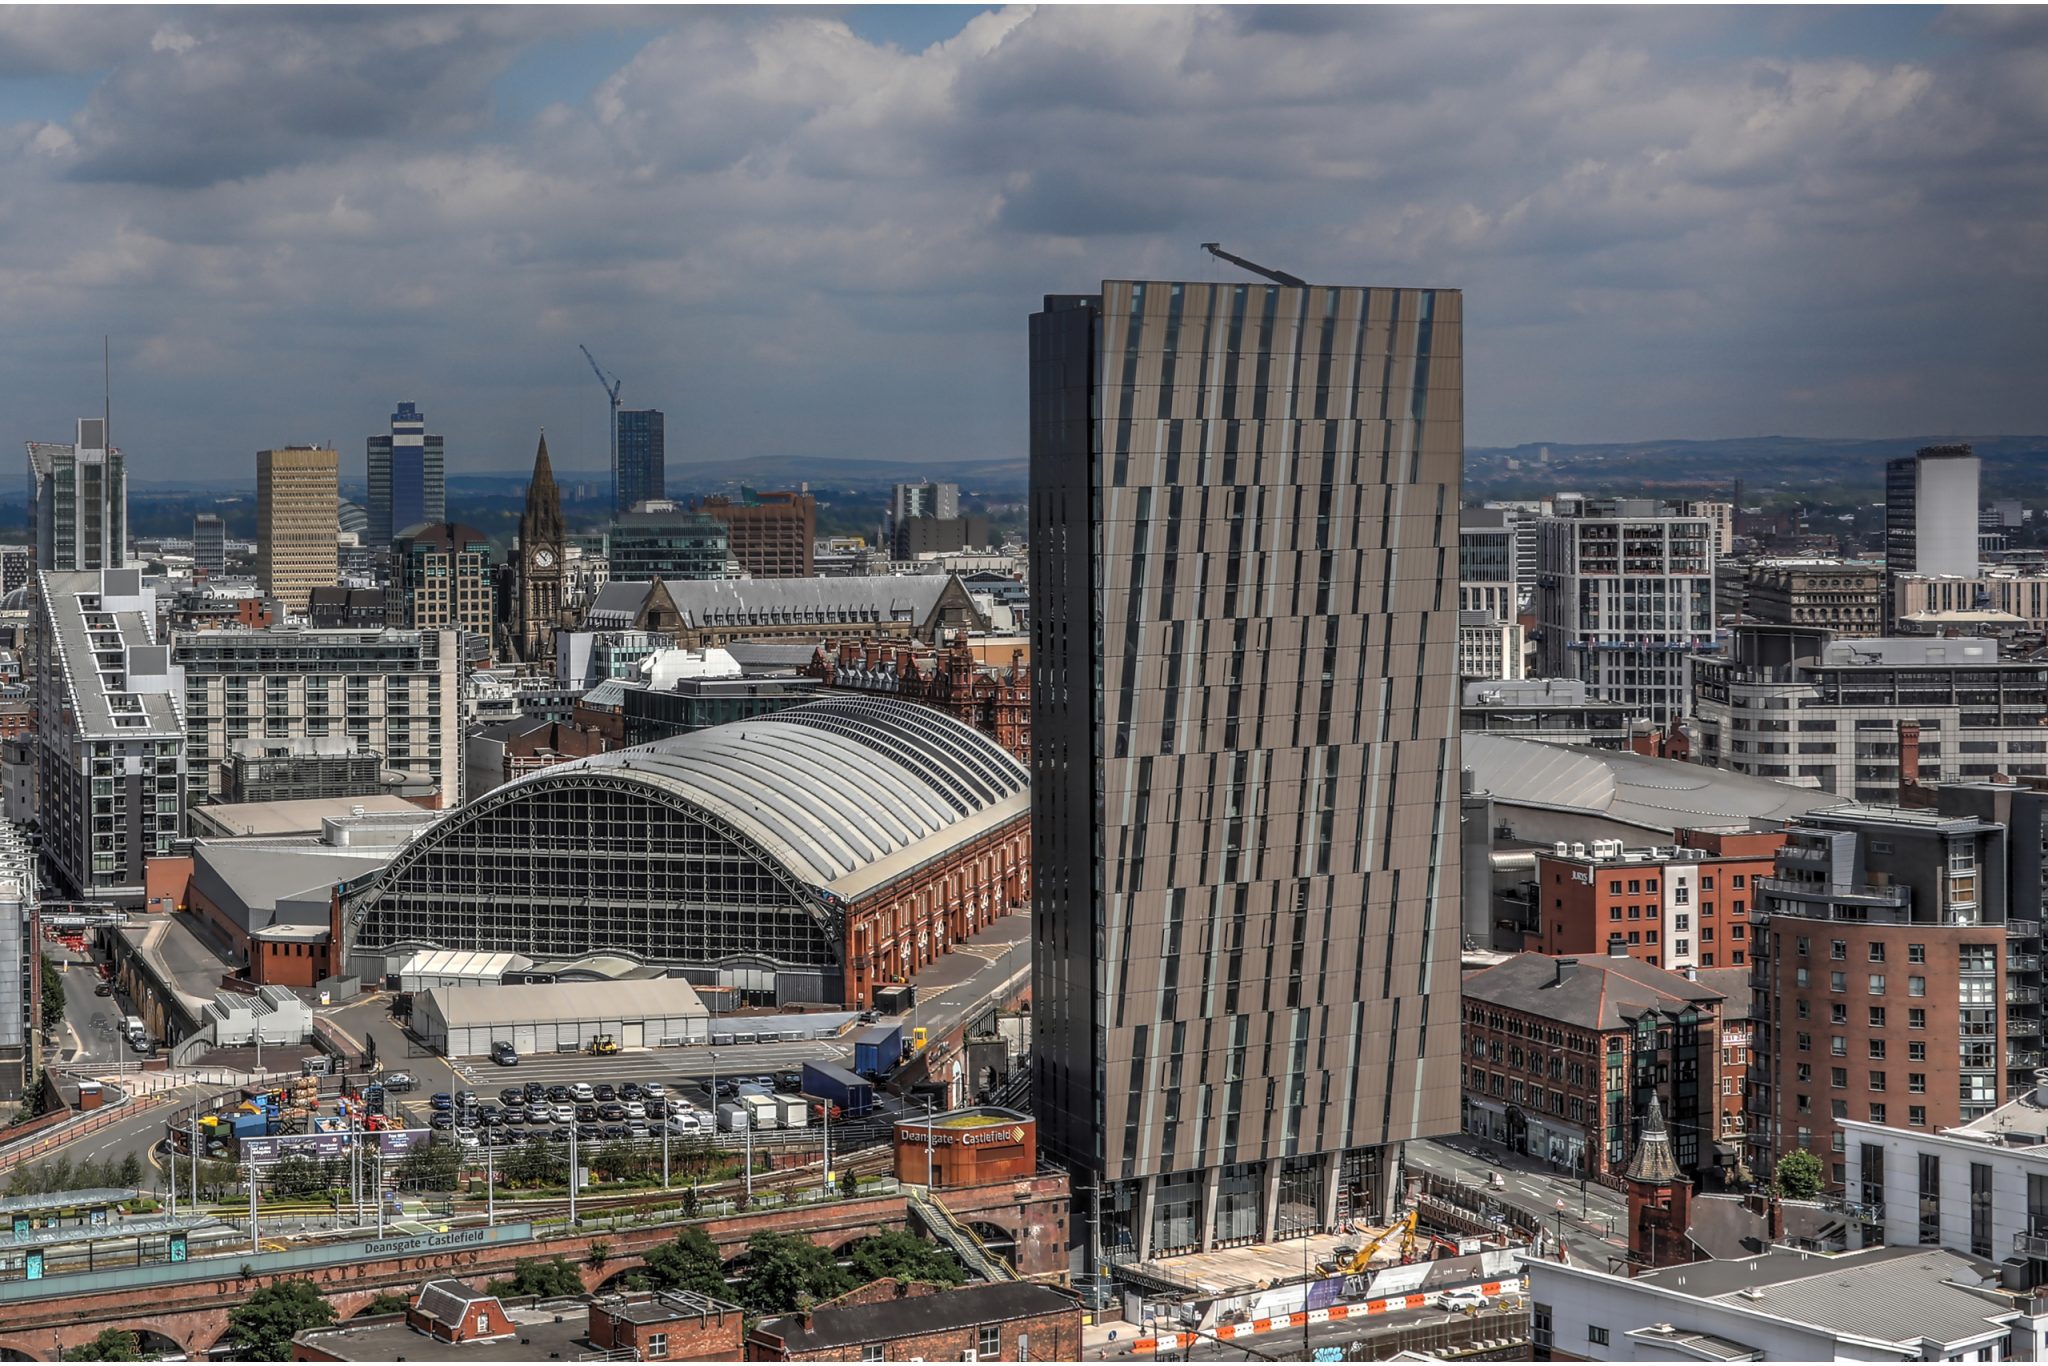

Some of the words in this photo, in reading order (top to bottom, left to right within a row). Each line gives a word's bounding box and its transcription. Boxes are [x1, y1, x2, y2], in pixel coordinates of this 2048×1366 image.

[962, 1129, 1011, 1145] Castlefield
[365, 1240, 421, 1254] Deansgate
[428, 1231, 484, 1246] Castlefield
[398, 1251, 479, 1273] LOCKS
